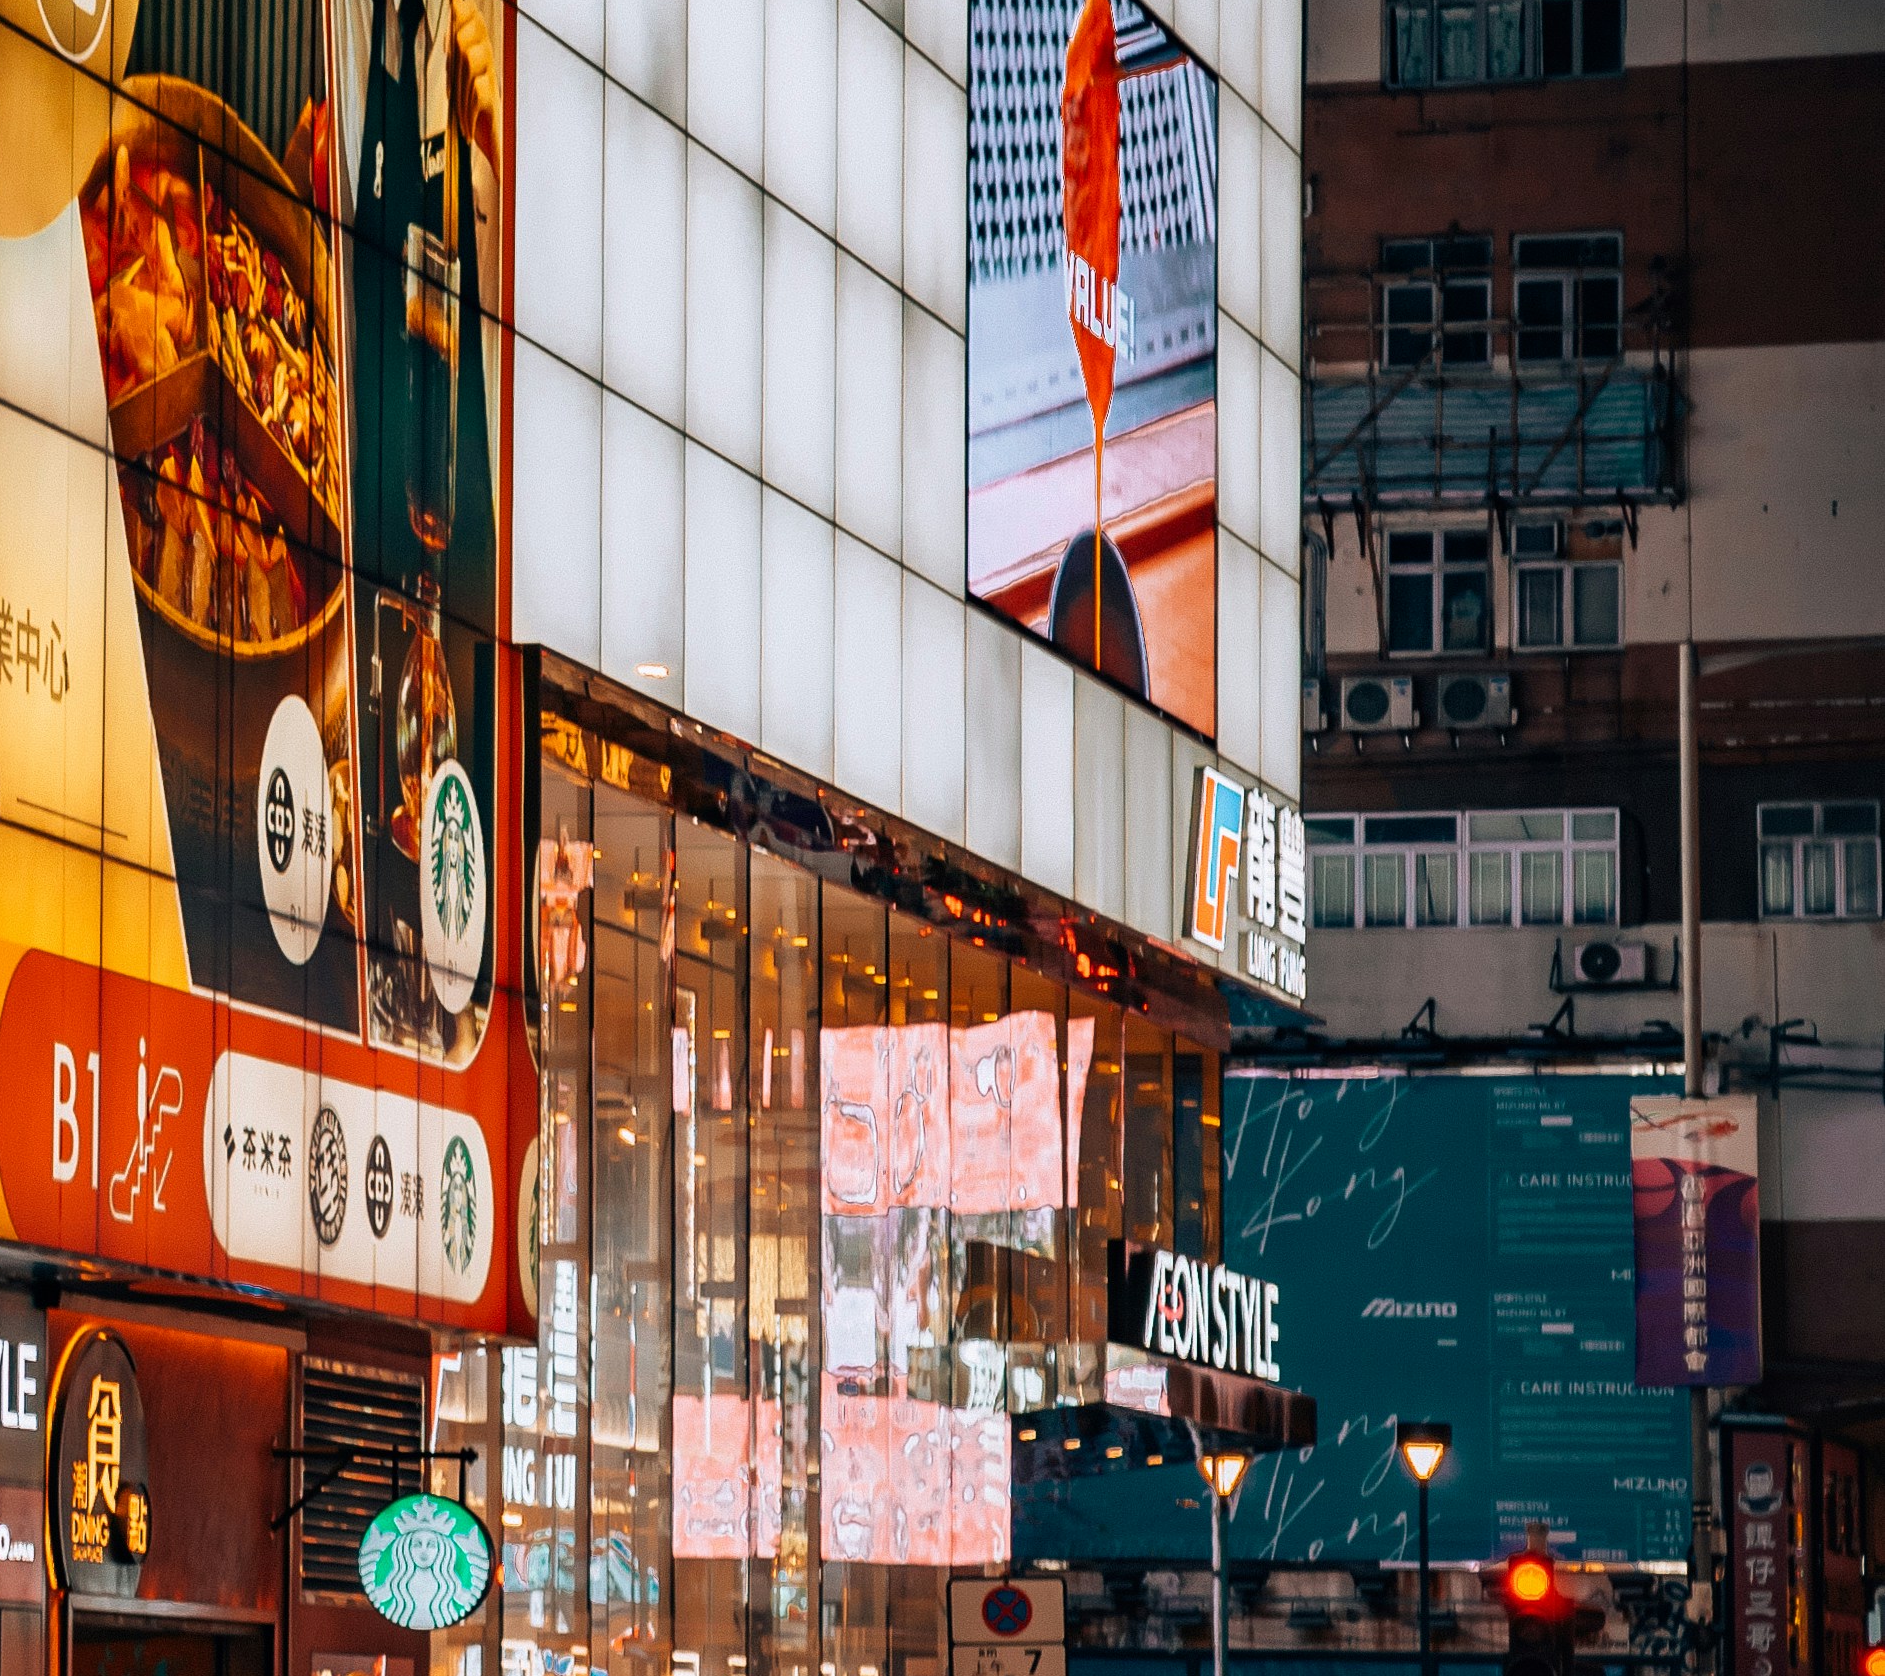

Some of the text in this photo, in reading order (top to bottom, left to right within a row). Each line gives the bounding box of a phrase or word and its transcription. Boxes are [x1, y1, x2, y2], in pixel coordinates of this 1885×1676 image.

[1247, 930, 1306, 1001] LUNG FUNG
[51, 1041, 101, 1191] B1
[242, 1124, 293, 1179] 茶米茶
[1519, 1173, 1561, 1188] CARE
[1211, 1262, 1279, 1381] STYLE
[1521, 1381, 1562, 1396] CARE
[1024, 1649, 1043, 1676] 7
